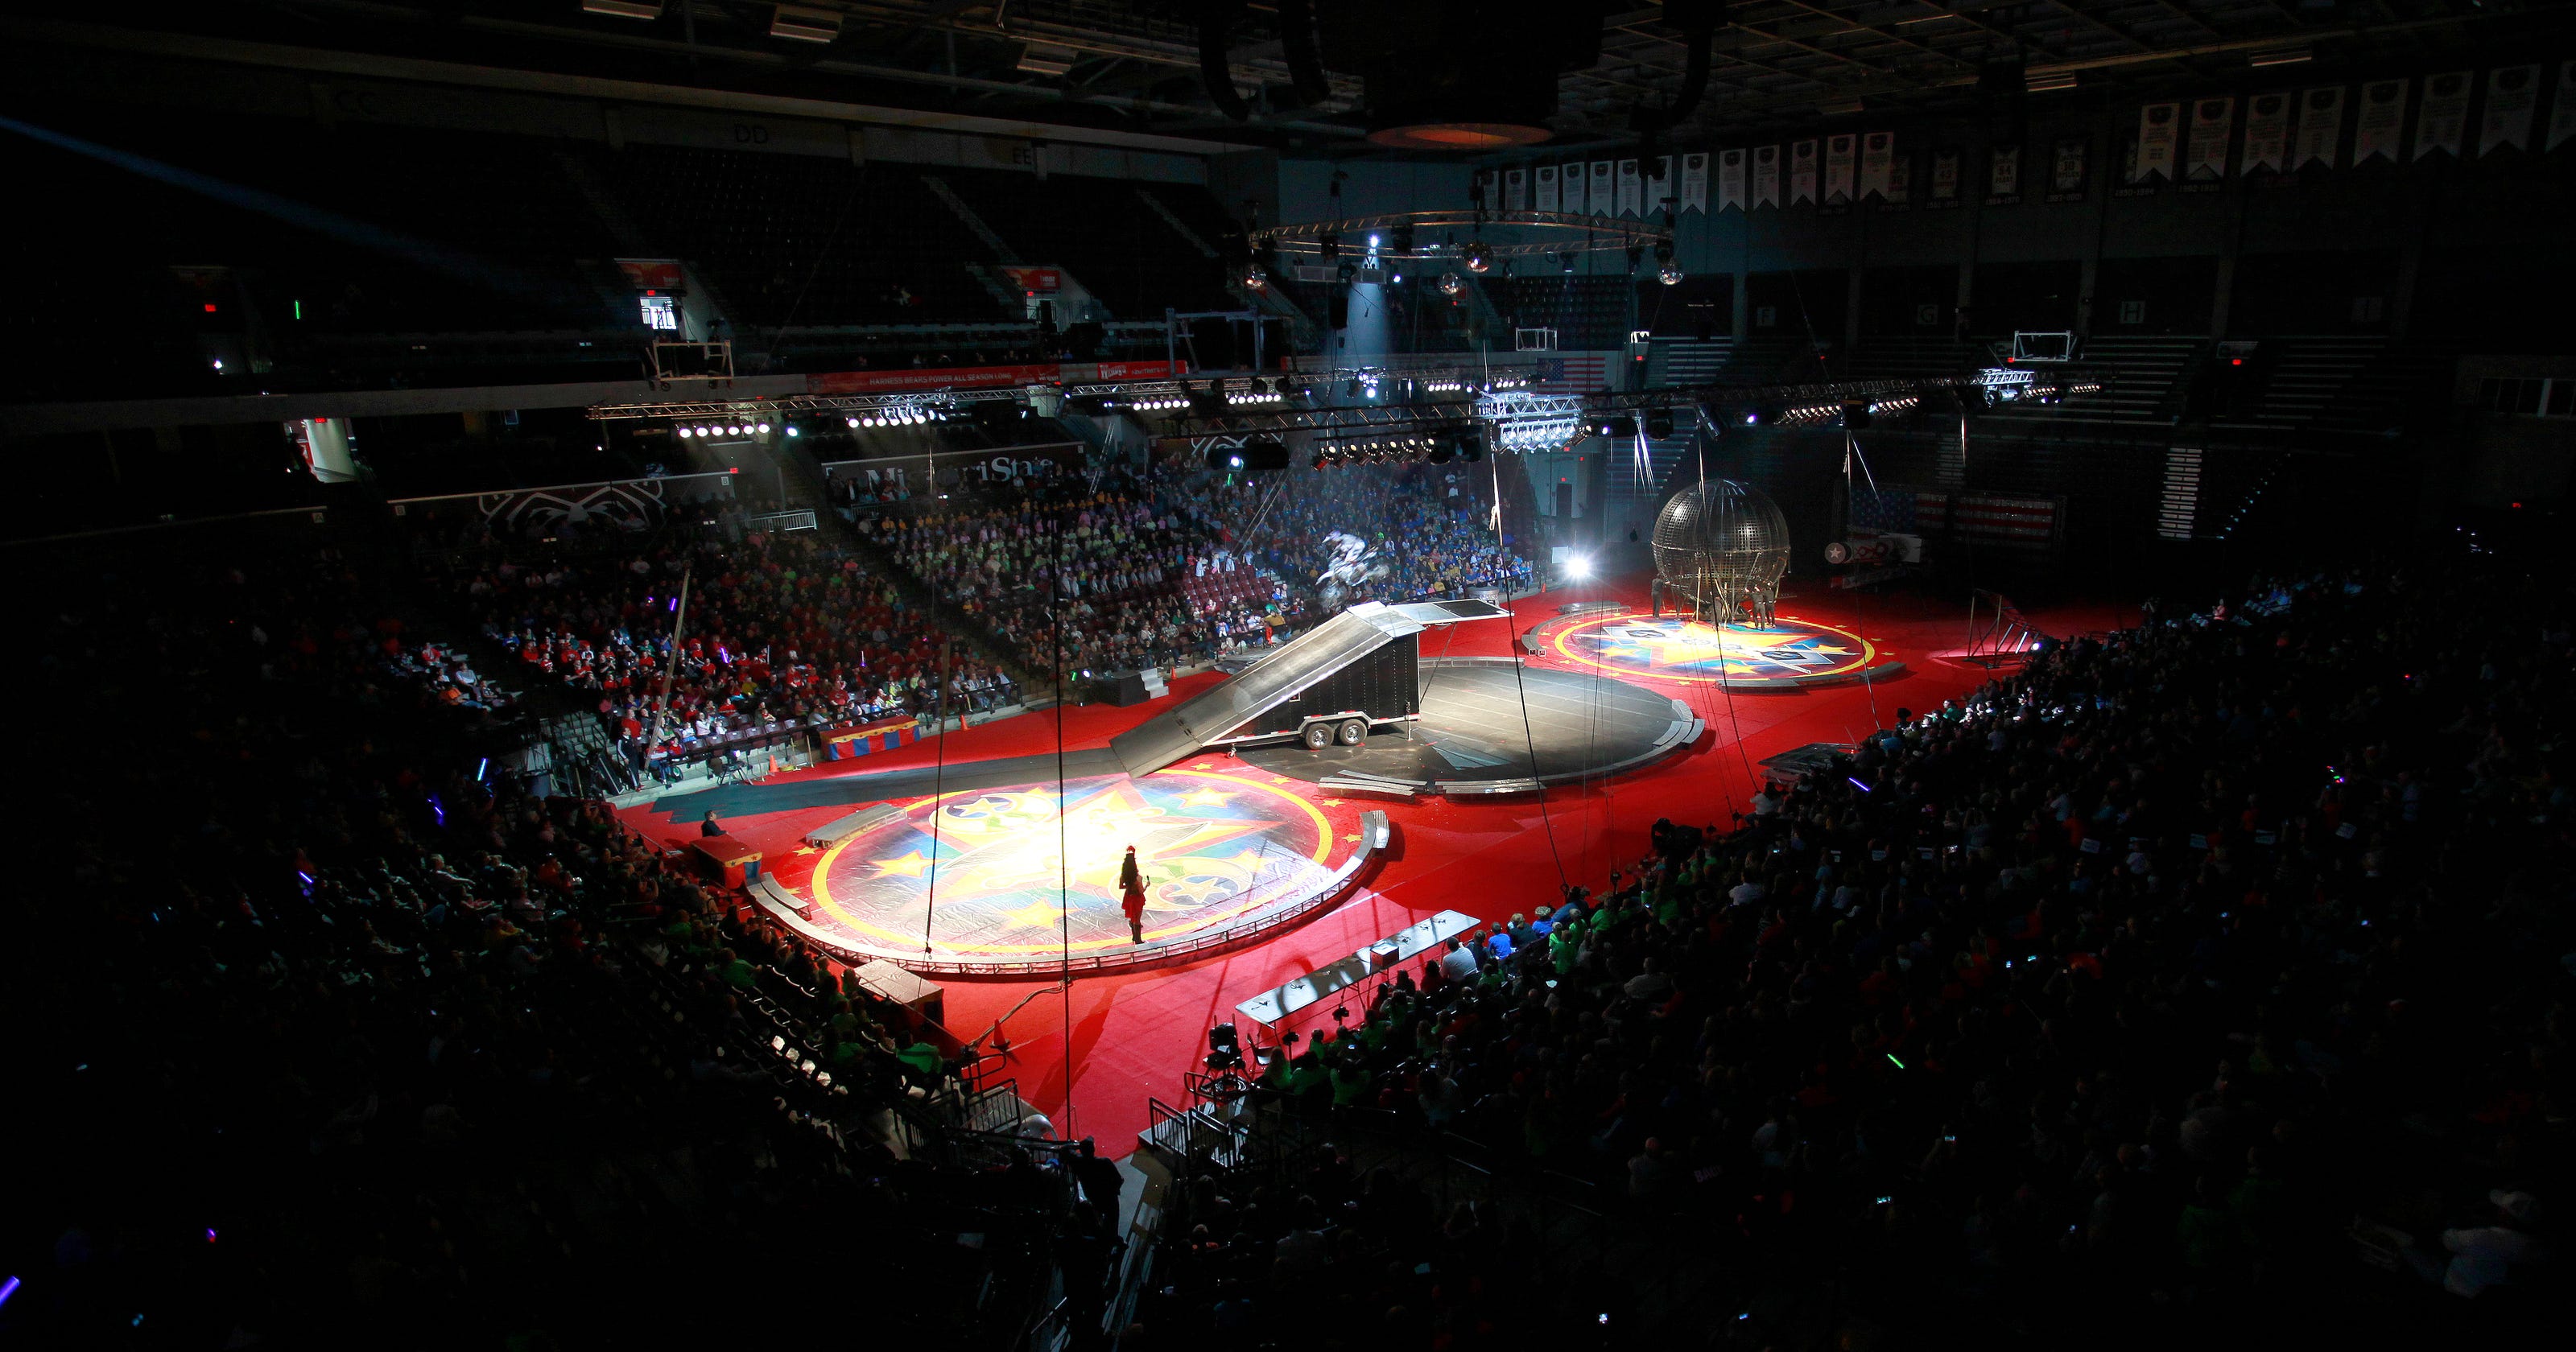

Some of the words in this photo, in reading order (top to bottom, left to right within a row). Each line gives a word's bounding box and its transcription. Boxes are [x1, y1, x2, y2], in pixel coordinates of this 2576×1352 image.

[734, 124, 769, 144] DD
[1012, 146, 1032, 165] EE
[1921, 306, 1935, 323] G
[2124, 302, 2140, 322] H
[869, 377, 903, 386] HARNESS
[904, 376, 927, 384] BEARS
[928, 374, 952, 383] POWER
[954, 373, 966, 381] ALL
[967, 373, 993, 381] SEASON
[994, 372, 1012, 380] LONG
[991, 455, 1054, 483] Stae
